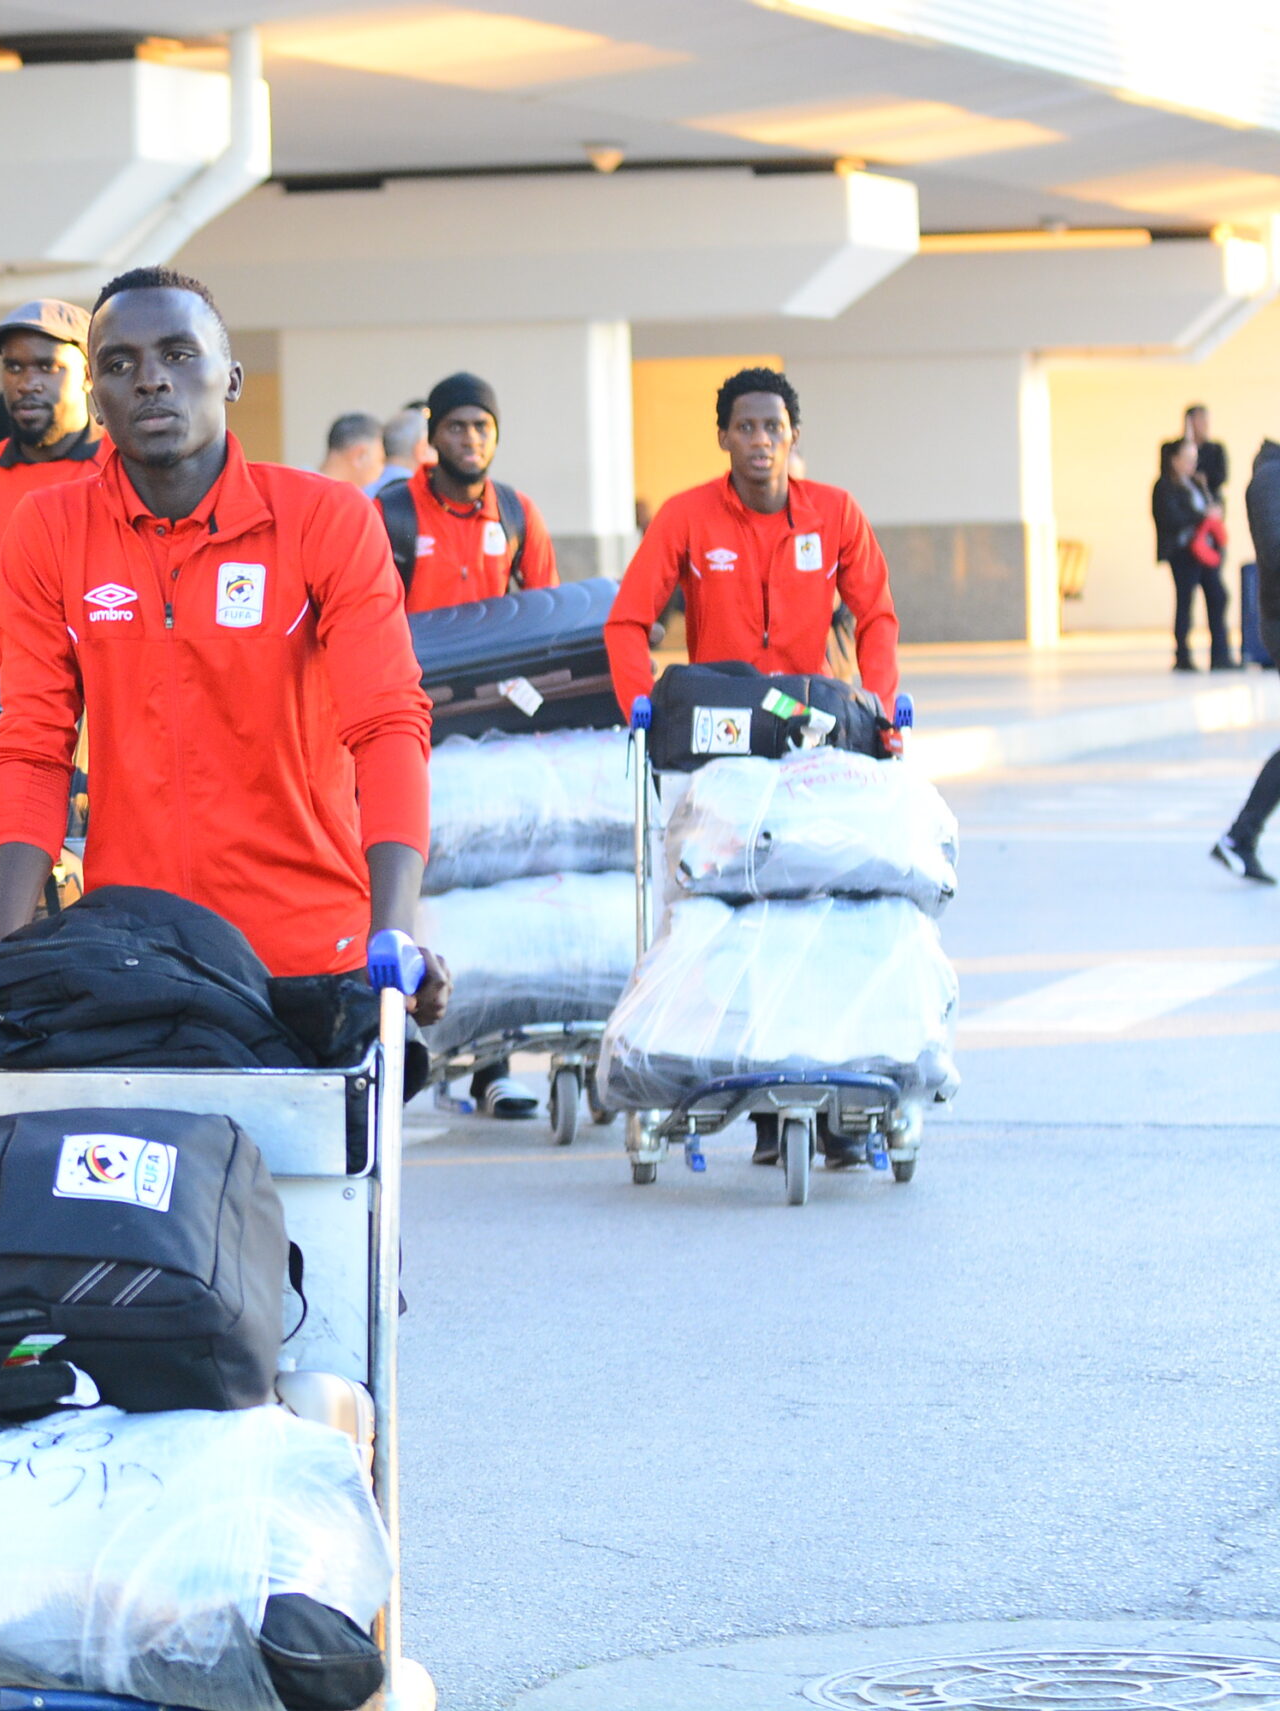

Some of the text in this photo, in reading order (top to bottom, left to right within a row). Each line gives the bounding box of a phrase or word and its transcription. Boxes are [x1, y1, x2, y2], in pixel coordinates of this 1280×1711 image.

[89, 607, 134, 622] umbro
[223, 610, 252, 620] FUFA
[142, 1154, 161, 1193] FUFA
